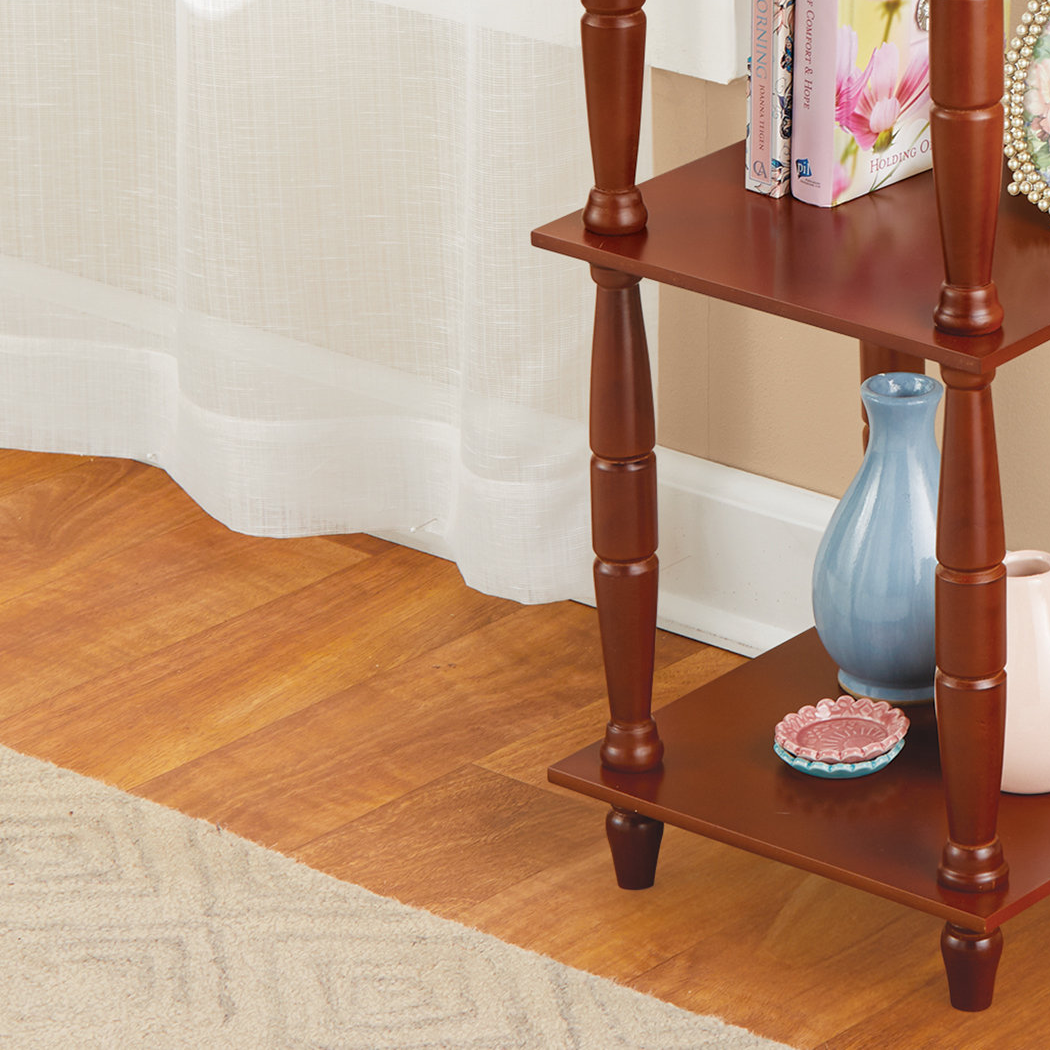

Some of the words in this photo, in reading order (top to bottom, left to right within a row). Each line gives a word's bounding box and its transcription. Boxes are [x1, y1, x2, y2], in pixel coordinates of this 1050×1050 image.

[804, 10, 815, 65] COMFORT
[804, 66, 813, 75] &
[803, 79, 813, 110] HOPE
[869, 147, 917, 174] HOLDING
[919, 139, 932, 154] O
